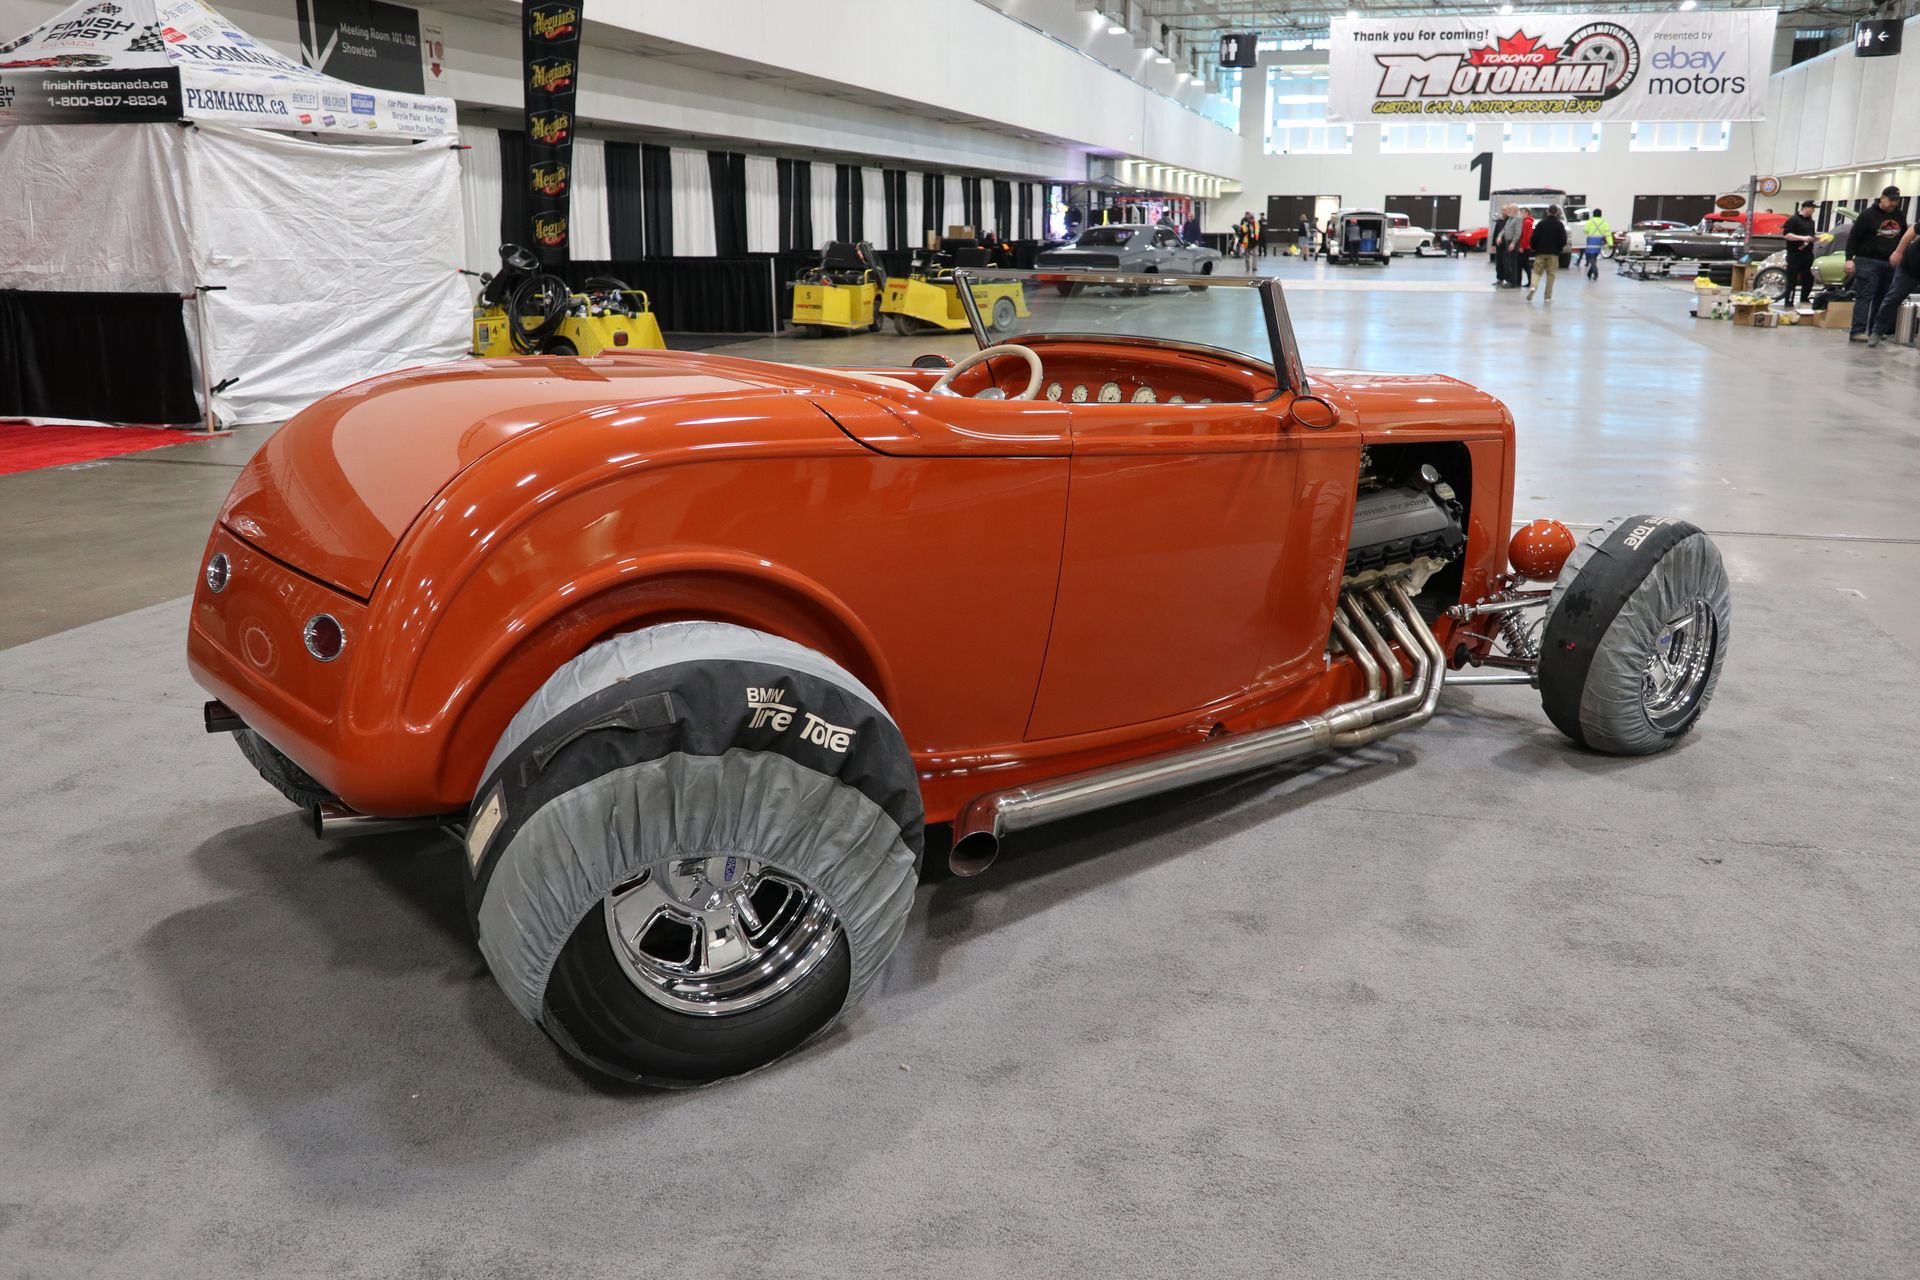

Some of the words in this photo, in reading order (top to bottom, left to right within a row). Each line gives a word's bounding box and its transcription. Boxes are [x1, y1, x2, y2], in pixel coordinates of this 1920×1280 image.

[50, 17, 135, 31] FINISH
[340, 22, 369, 40] Meeting
[370, 28, 390, 40] Room
[43, 29, 120, 42] FIRST
[1353, 31, 1389, 42] Thank
[1393, 32, 1414, 43] you
[1418, 30, 1436, 41] for
[1439, 29, 1489, 42] coming!
[1653, 32, 1699, 41] Presented
[1702, 31, 1713, 41] by
[342, 42, 377, 58] Showtech
[1482, 53, 1545, 64] TORONTO
[1651, 45, 1727, 74] ebay
[1374, 53, 1607, 97] MOTORAMA
[42, 80, 169, 91] finishfirstcanada.ca
[1649, 73, 1746, 95] motors
[47, 95, 168, 107] 1-800-807-8834
[185, 88, 289, 116] PL8MAKER.ca
[1371, 100, 1422, 114] CUSTOM
[1424, 100, 1450, 114] CAR
[1454, 101, 1465, 114] &
[1466, 100, 1564, 114] MOTORSPORTS
[1565, 100, 1602, 114] EXPO
[1470, 152, 1493, 200] 1
[746, 687, 785, 702] BMW
